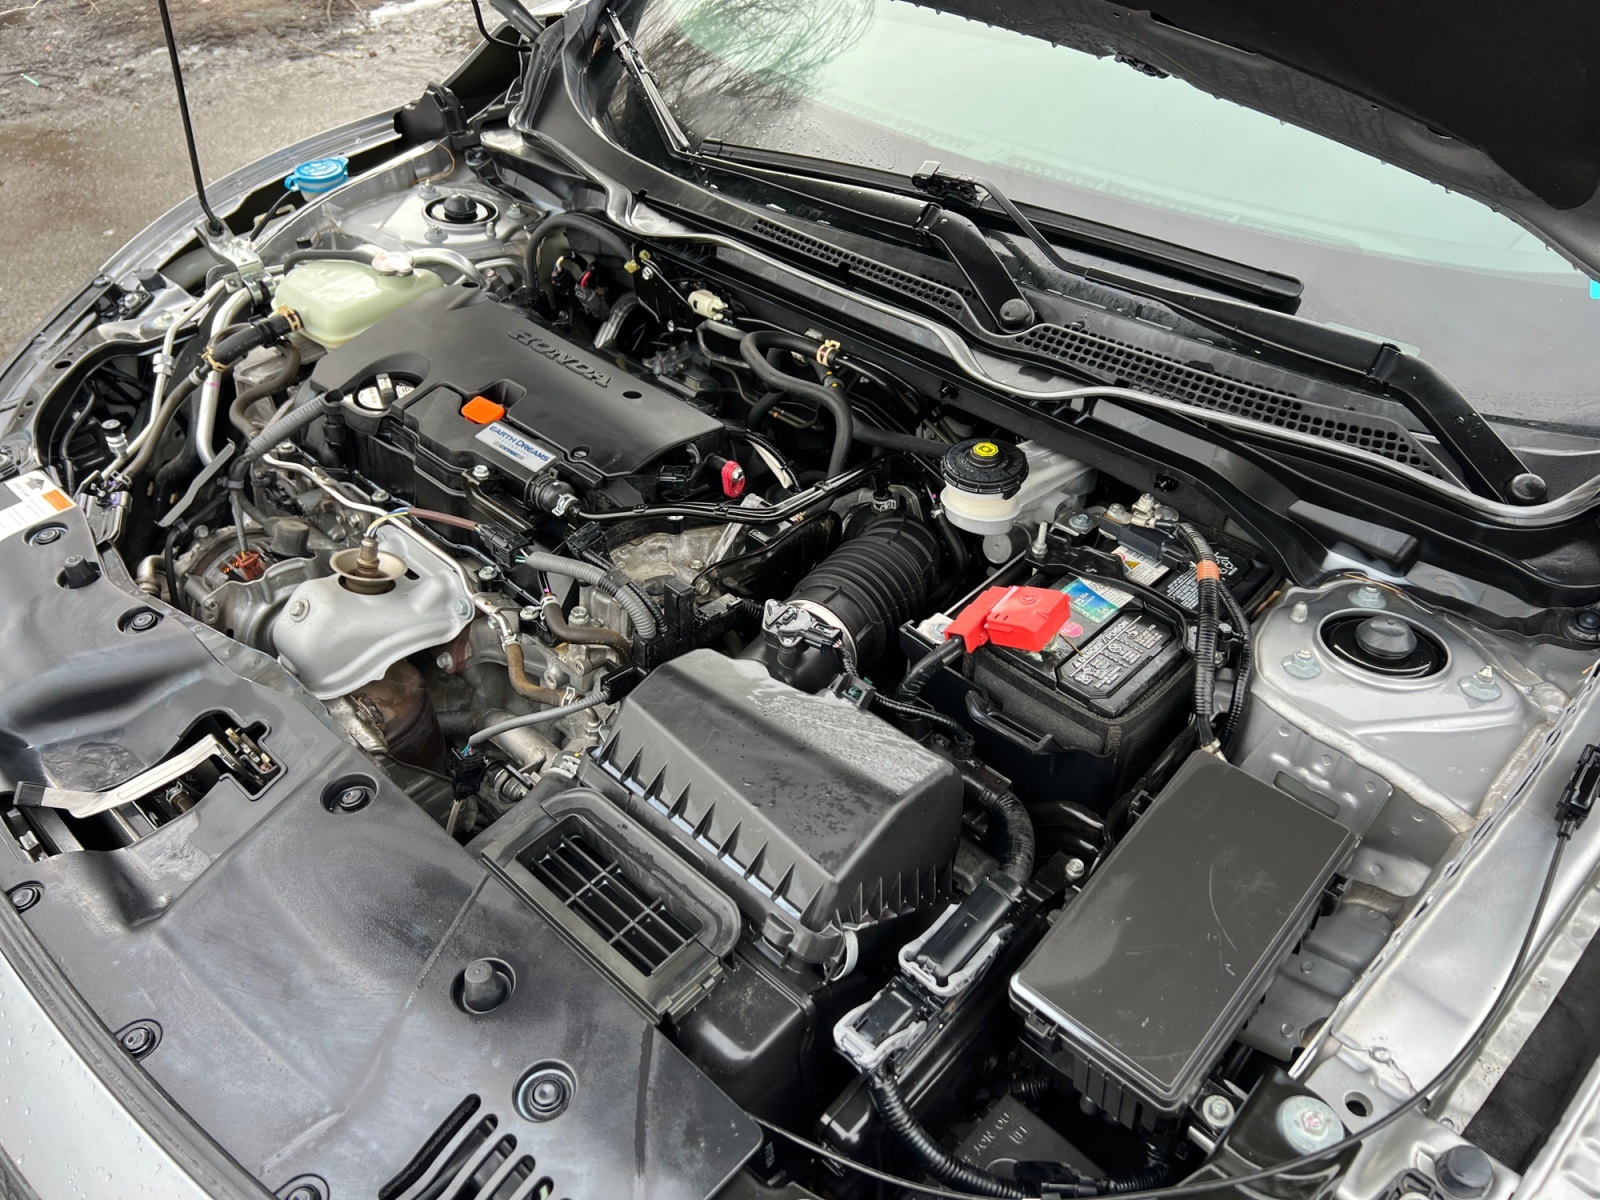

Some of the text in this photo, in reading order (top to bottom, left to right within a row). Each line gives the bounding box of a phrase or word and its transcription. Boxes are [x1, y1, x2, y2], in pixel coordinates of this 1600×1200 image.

[507, 328, 611, 389] HONDA
[489, 425, 550, 462] EARTH DREAMS
